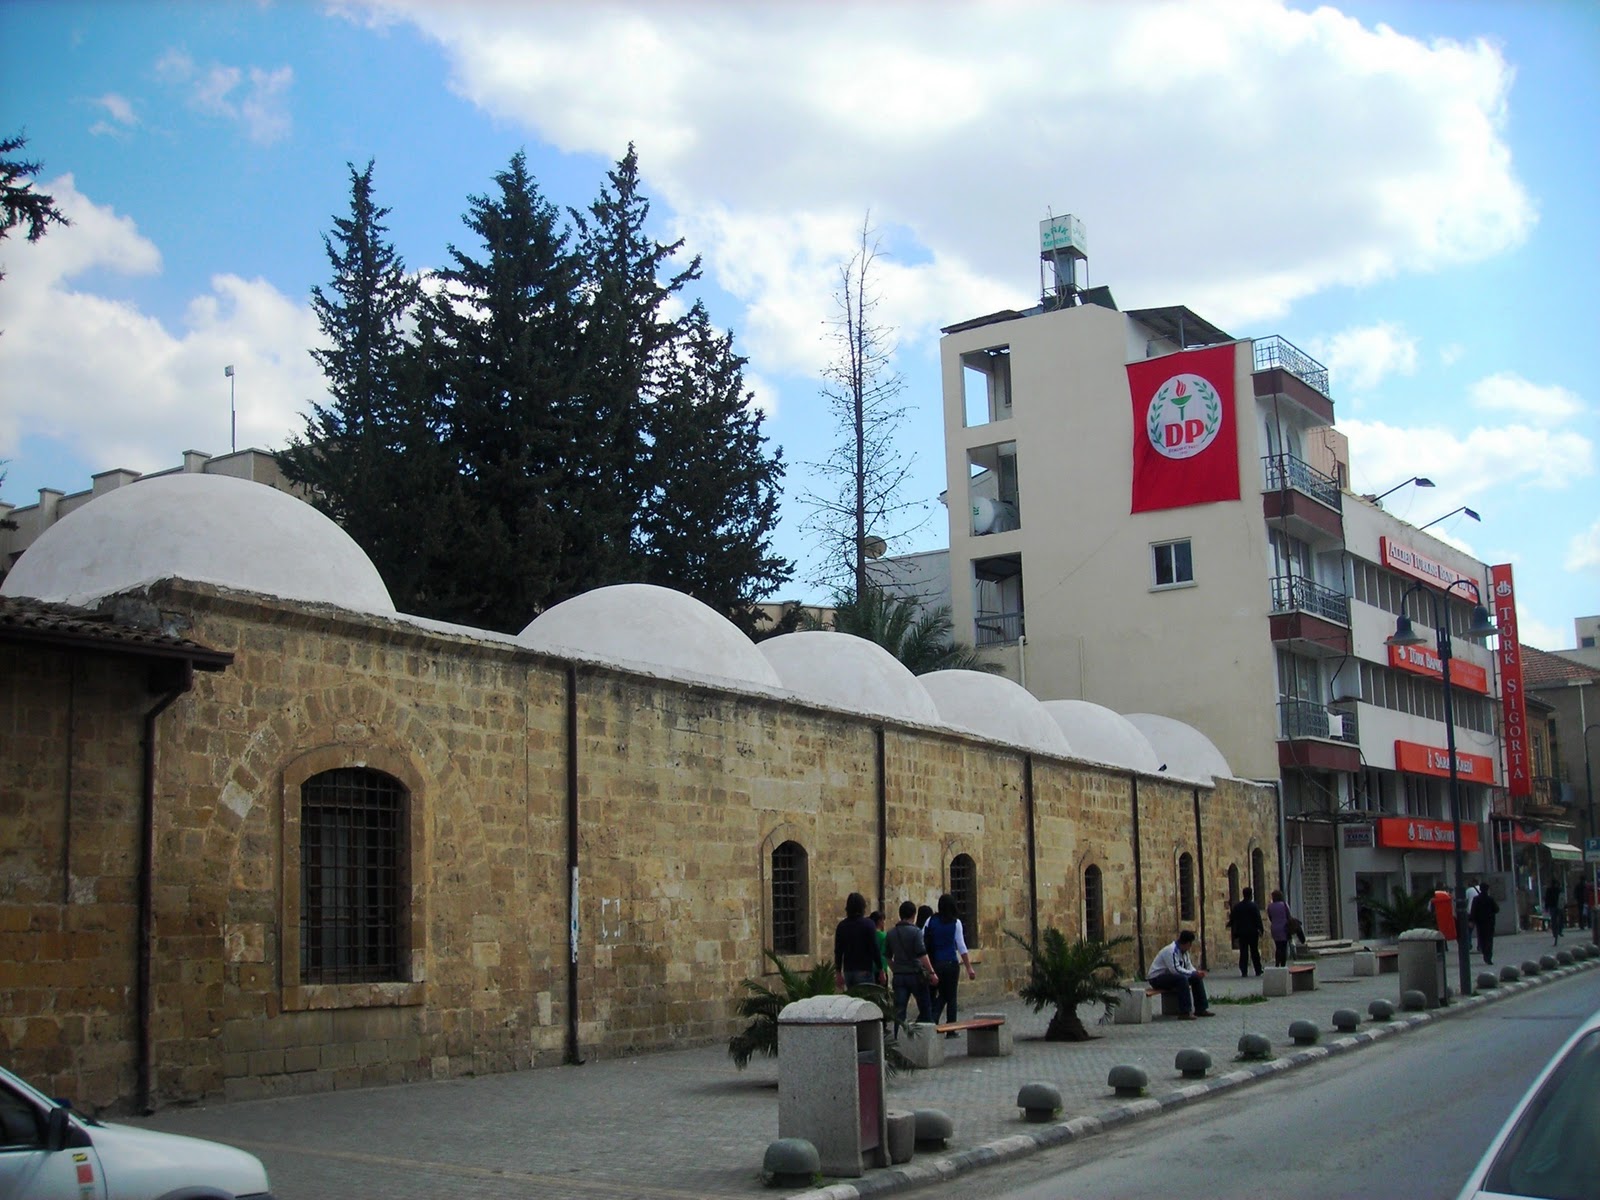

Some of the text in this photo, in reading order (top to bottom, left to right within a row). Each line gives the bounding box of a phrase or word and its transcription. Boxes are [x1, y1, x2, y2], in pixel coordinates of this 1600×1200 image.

[1165, 419, 1204, 447] DP
[1389, 542, 1411, 566] ALLIED
[1411, 552, 1437, 578] TURKISH
[1500, 607, 1524, 779] TÜRK SİGORTA
[1589, 840, 1597, 849] P
